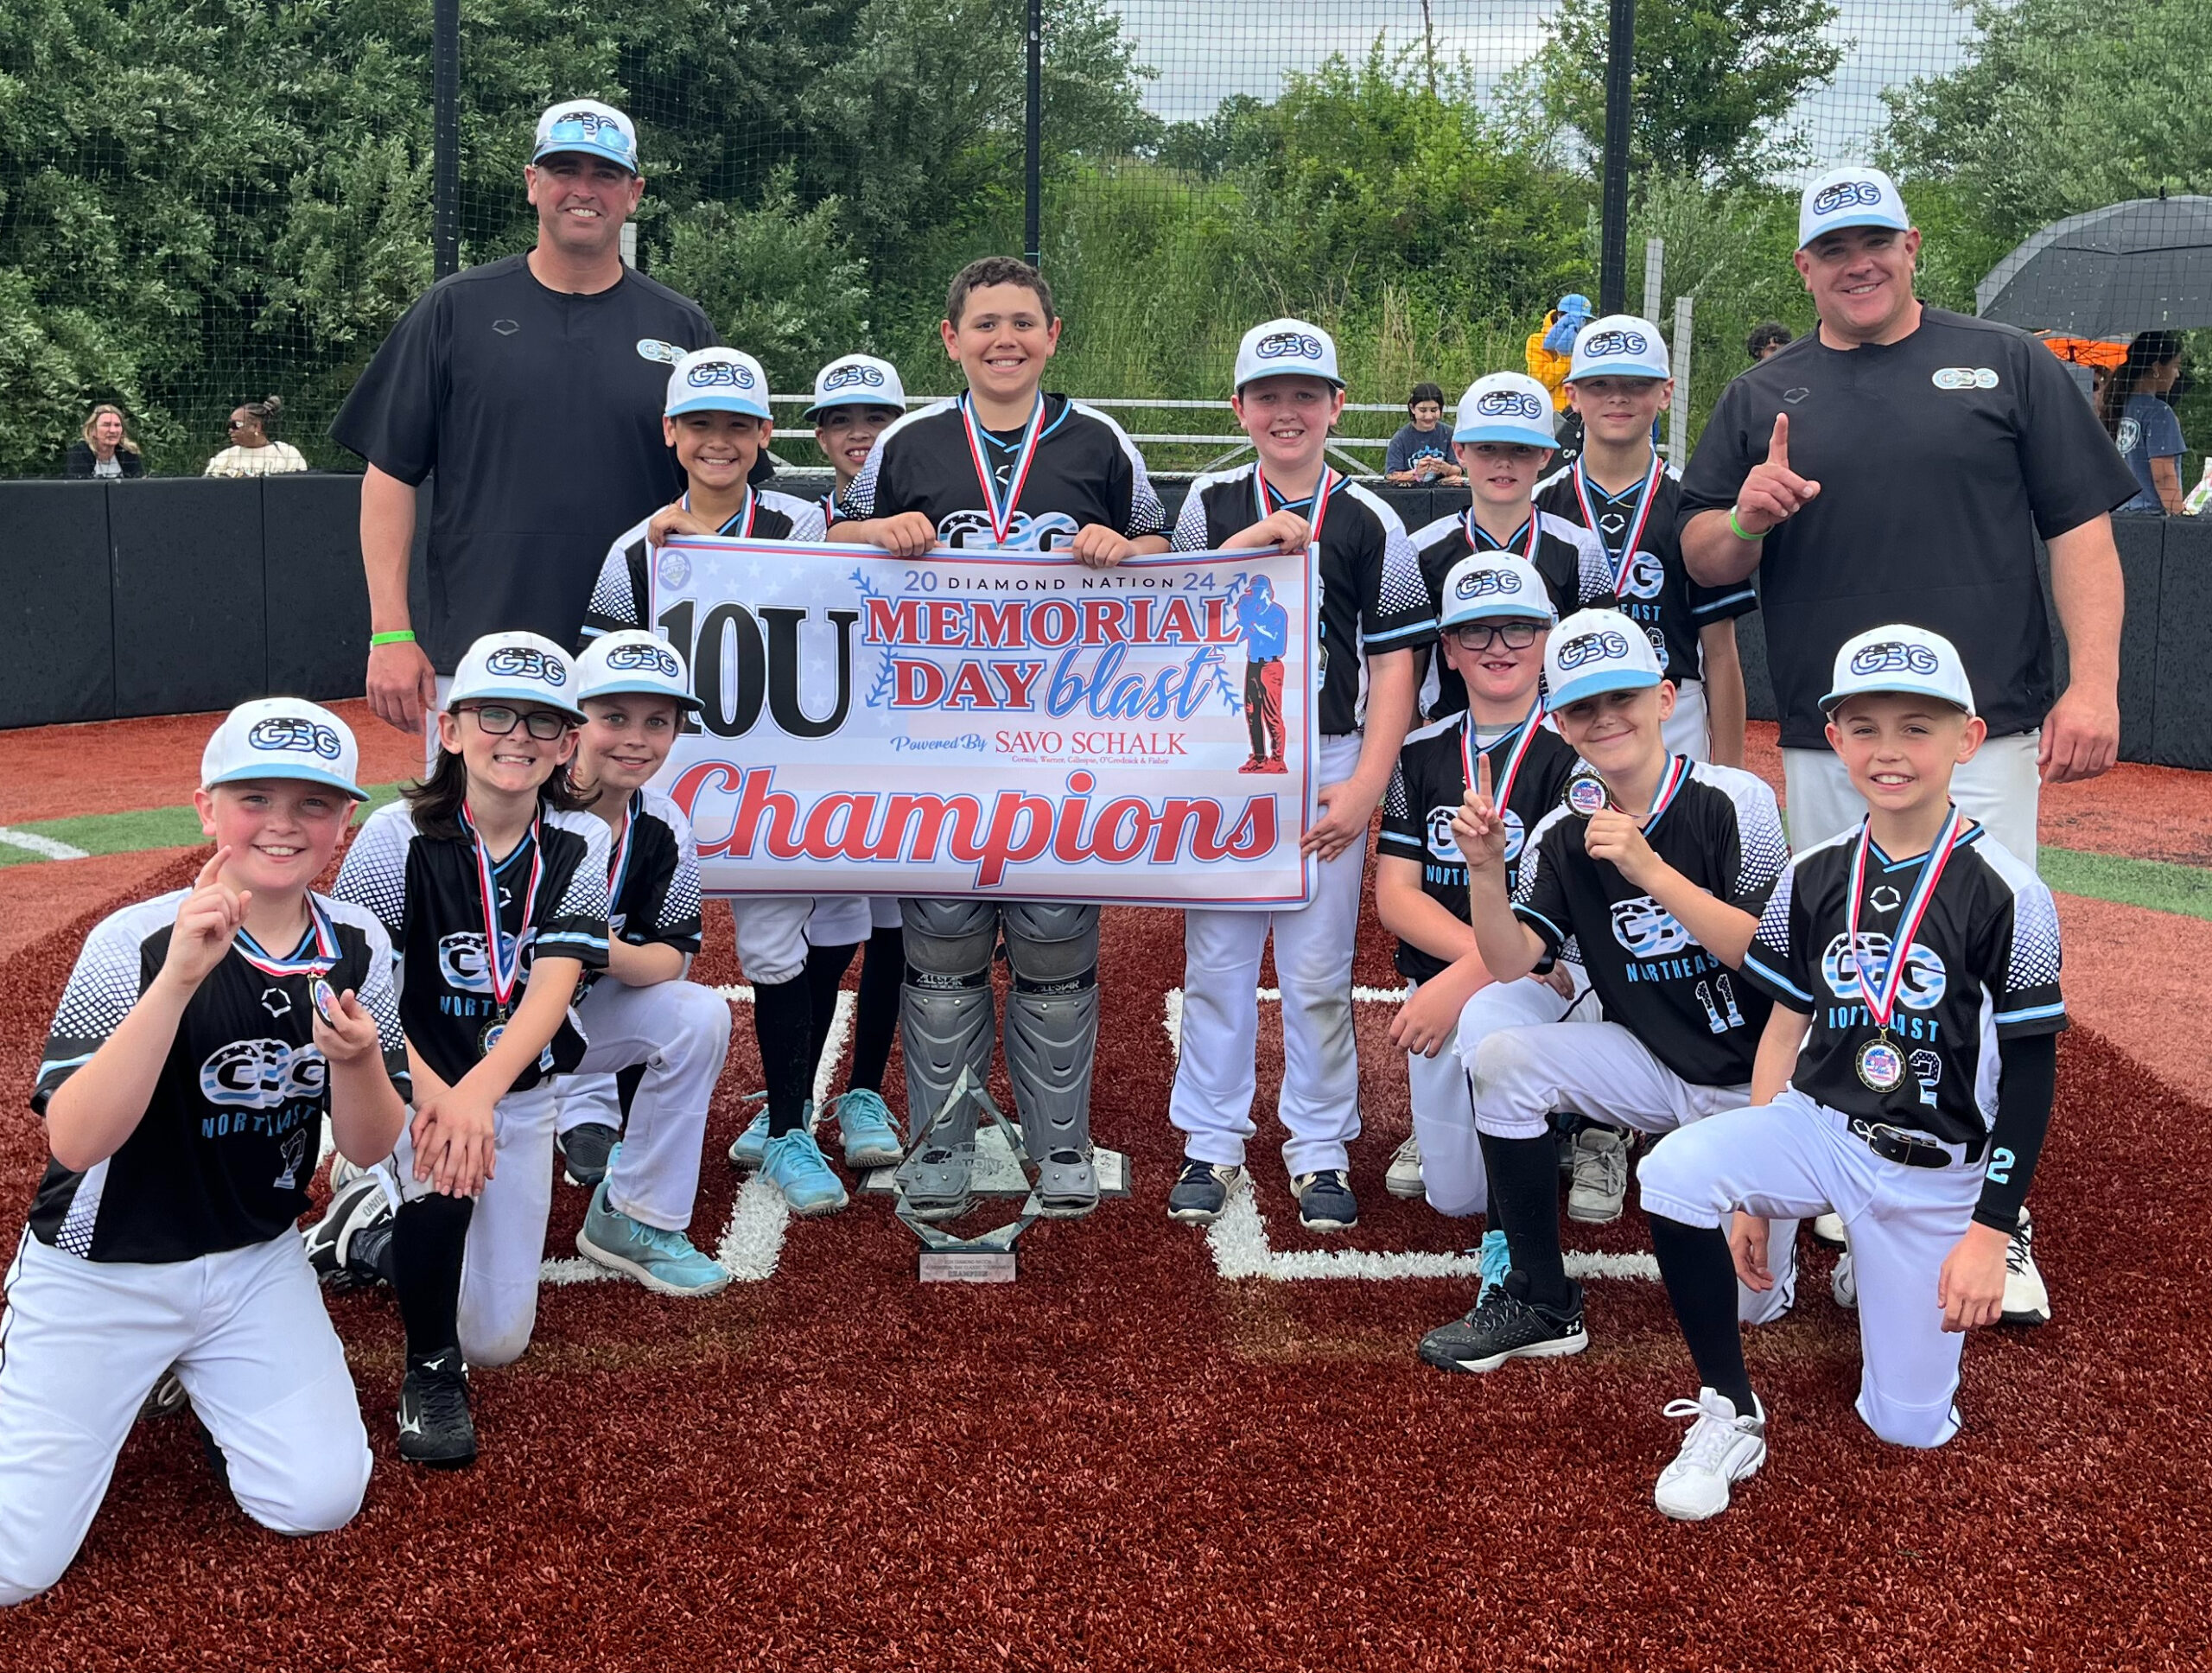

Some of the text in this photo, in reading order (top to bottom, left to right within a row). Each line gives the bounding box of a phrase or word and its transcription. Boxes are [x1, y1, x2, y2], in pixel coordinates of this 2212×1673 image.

[1813, 181, 1882, 215] GBG
[1255, 332, 1323, 359] GBG
[1584, 330, 1648, 358] GBG
[687, 361, 755, 389] GBG
[823, 364, 885, 391] GBG
[1477, 391, 1542, 419] GBG
[904, 570, 1216, 593] 20 DIAMOND NATION 24
[1455, 569, 1522, 600] GBG
[861, 594, 1243, 650] MEMORIAL
[486, 646, 567, 686] GBG
[606, 644, 679, 677] GBG
[1558, 630, 1630, 671] GBG
[1850, 641, 1939, 676] GBG
[656, 598, 862, 741] 10U
[888, 642, 1225, 721] DAY blast
[249, 717, 341, 760] GBG
[890, 733, 988, 754] Powered By
[995, 730, 1189, 754] SAVO SCHALK
[667, 759, 1279, 889] Champions
[1695, 973, 1745, 1034] 11
[1986, 1147, 2016, 1184] 2
